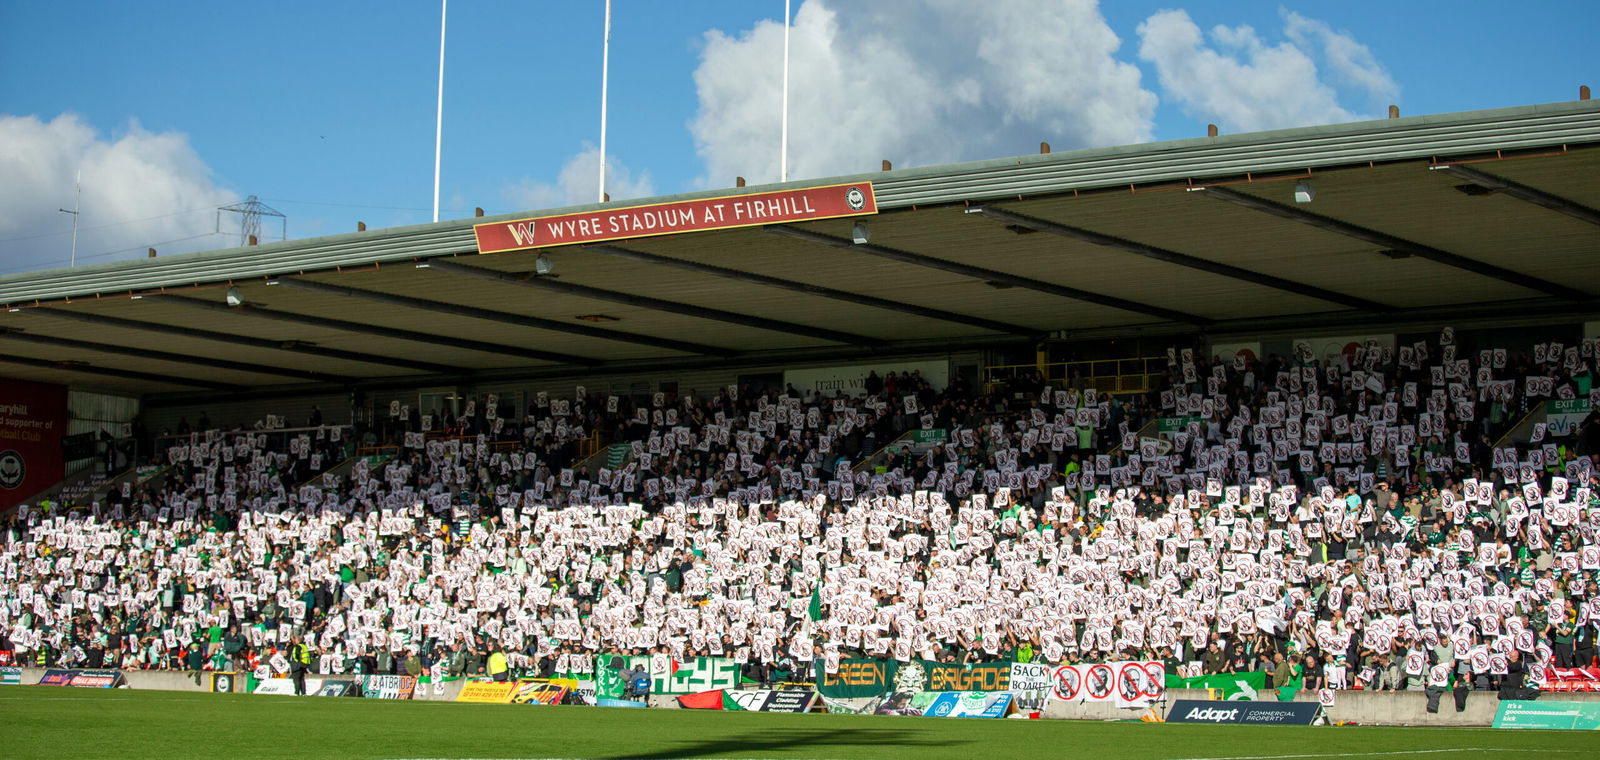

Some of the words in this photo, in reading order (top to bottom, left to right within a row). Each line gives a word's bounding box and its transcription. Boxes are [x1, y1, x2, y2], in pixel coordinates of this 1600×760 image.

[547, 217, 603, 239] WYRE
[609, 207, 696, 233] STADIUM
[703, 204, 726, 223] AT
[735, 195, 816, 218] FIRHILL
[815, 375, 845, 390] train
[1555, 400, 1574, 408] EXIT
[5, 417, 44, 429] supporter
[44, 420, 53, 431] of
[1165, 418, 1183, 426] EXIT
[920, 430, 936, 438] EXIT
[1013, 665, 1049, 677] SACK
[931, 667, 1010, 691] BRIGADE
[1012, 681, 1046, 691] BOARD
[1185, 707, 1239, 723] Adapt
